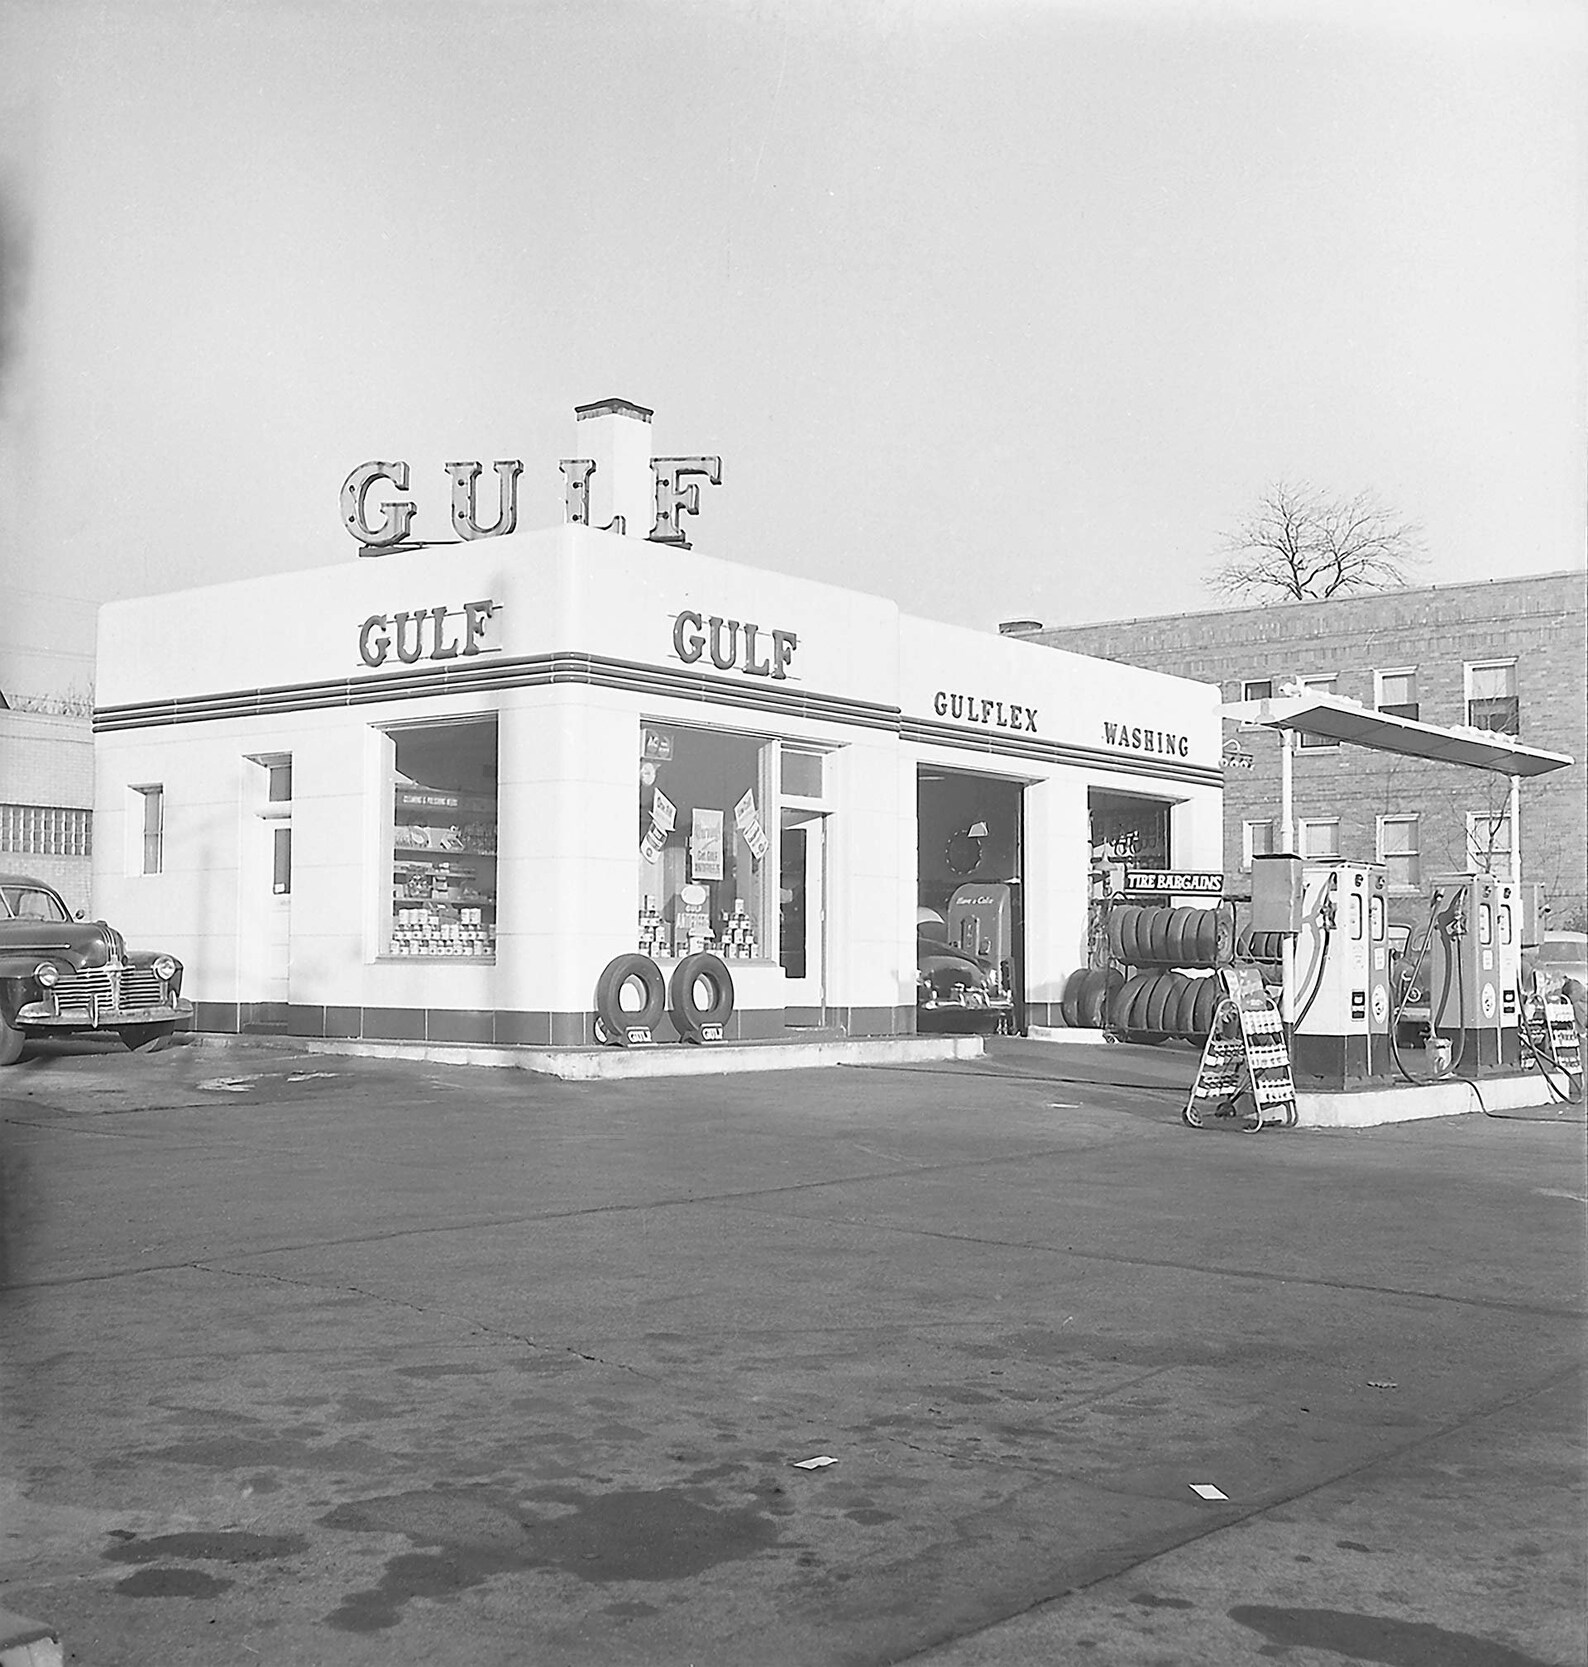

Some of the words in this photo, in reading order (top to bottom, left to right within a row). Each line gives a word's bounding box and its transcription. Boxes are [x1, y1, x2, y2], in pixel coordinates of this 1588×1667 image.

[340, 457, 723, 545] GULF
[360, 600, 493, 667] GULF
[673, 610, 798, 680] GULF
[934, 691, 1038, 732] GULFLEX
[1103, 721, 1189, 757] WASHING
[1127, 874, 1156, 888] TIRE
[1157, 875, 1222, 890] BARGAINS
[628, 1030, 652, 1043] GULF
[702, 1027, 723, 1040] GULF
